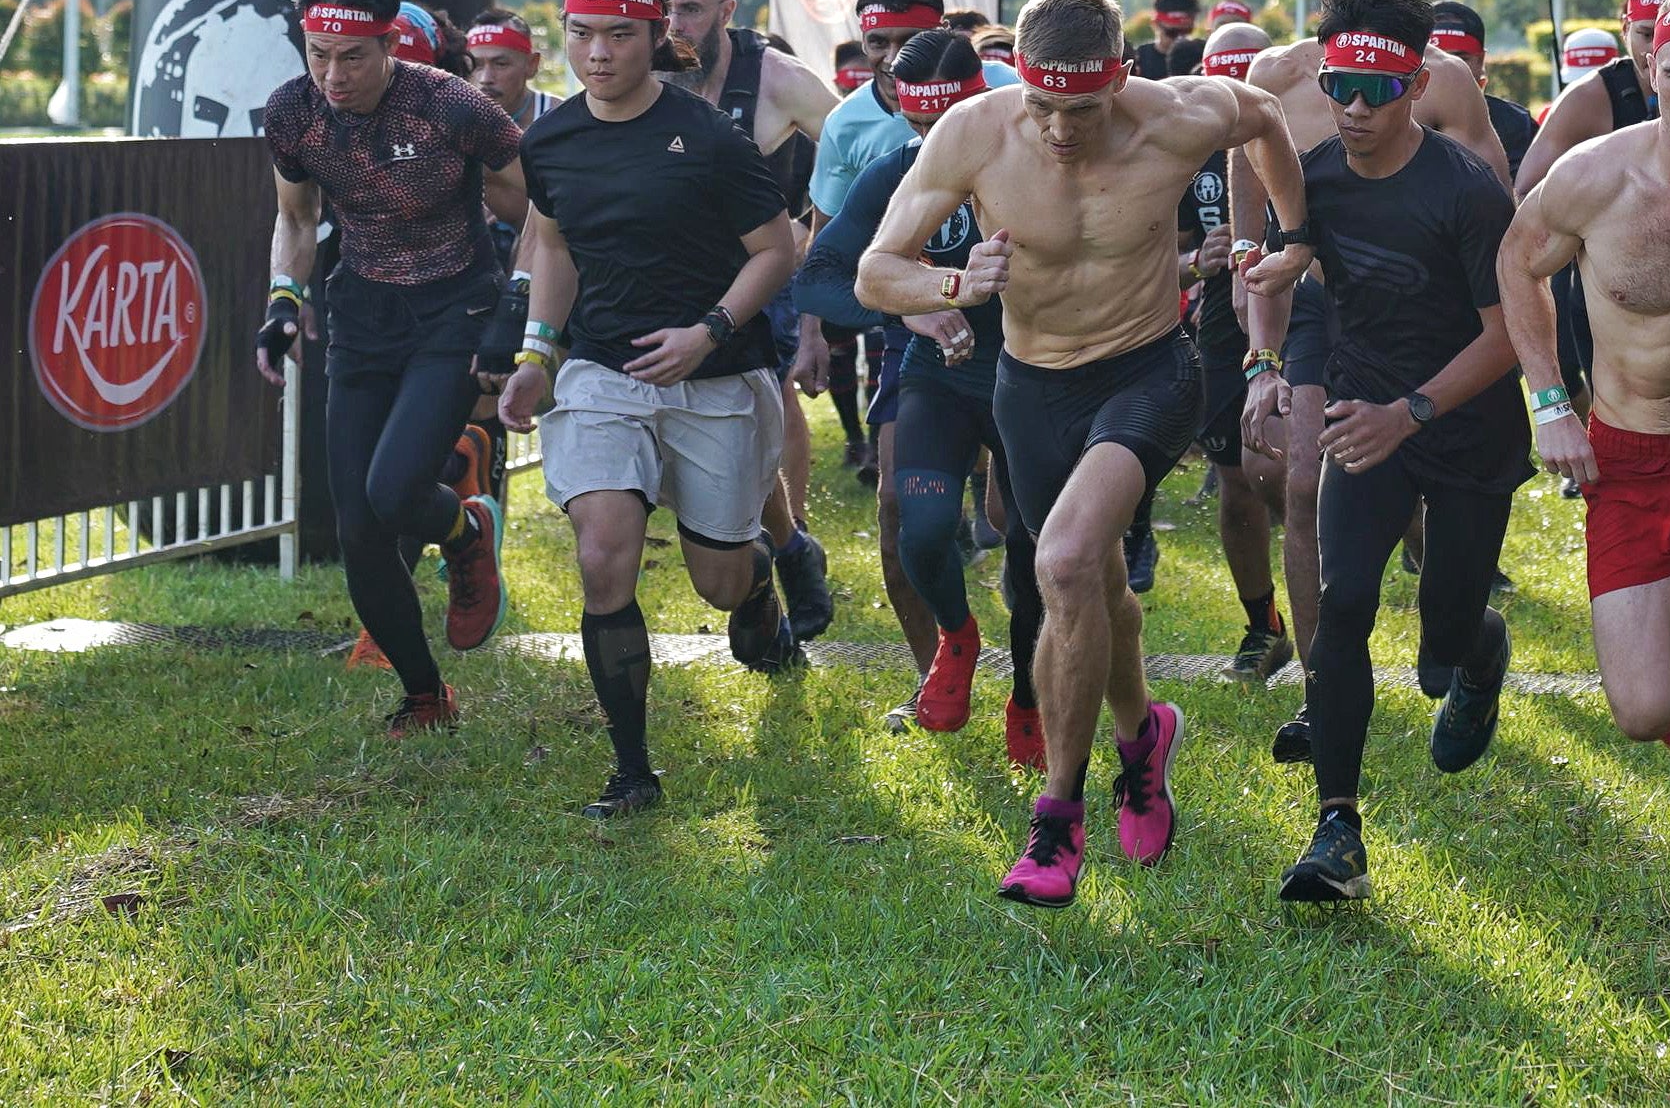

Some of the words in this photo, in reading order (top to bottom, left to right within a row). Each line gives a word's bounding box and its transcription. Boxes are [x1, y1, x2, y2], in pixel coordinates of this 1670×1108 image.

[321, 7, 374, 22] SPARTAN
[619, 3, 627, 14] 1
[322, 21, 342, 32] 70
[1351, 34, 1406, 58] SPARTAN
[1220, 53, 1260, 65] SPART
[1355, 50, 1377, 64] 24
[909, 81, 961, 97] SPARTAN
[1042, 75, 1067, 89] 63
[920, 97, 950, 110] 217
[53, 244, 179, 355] KARTA
